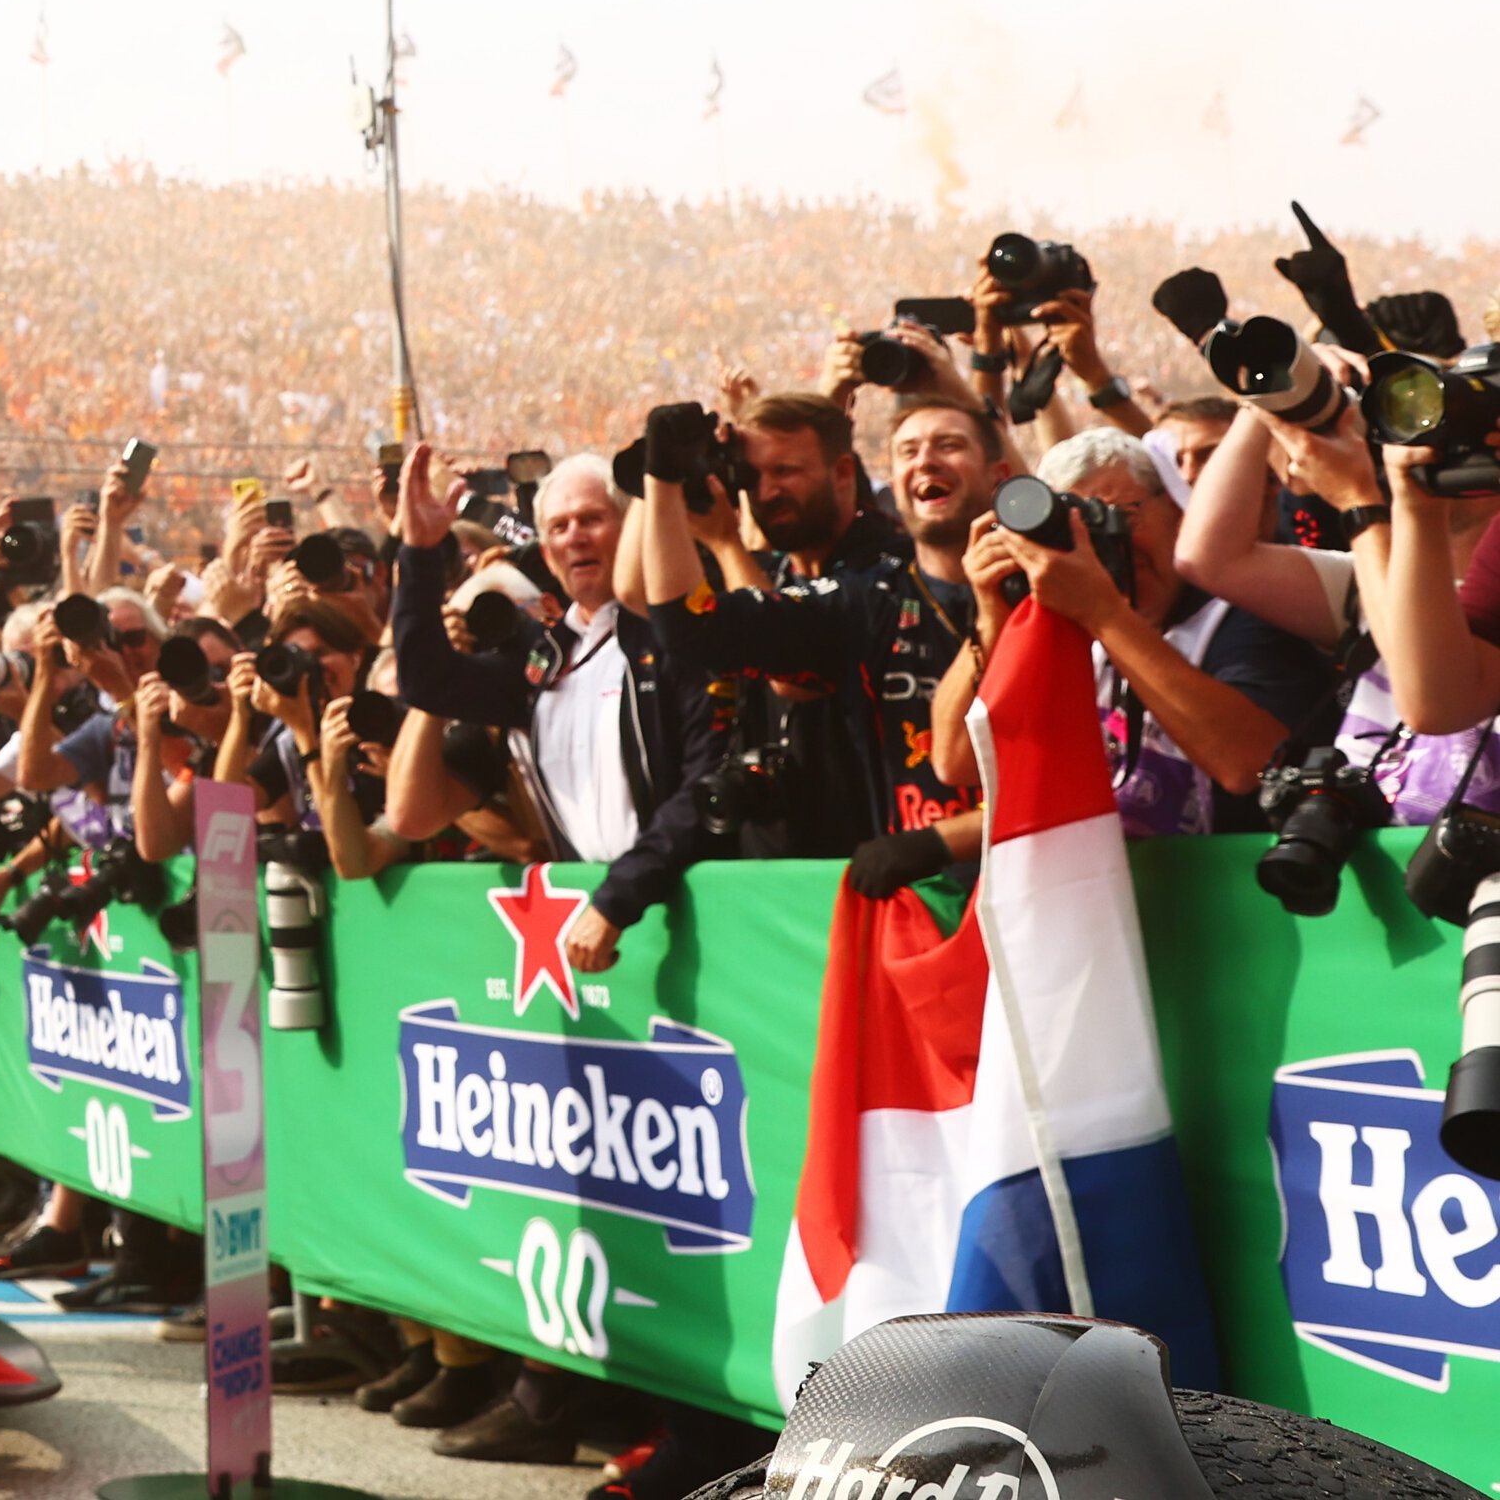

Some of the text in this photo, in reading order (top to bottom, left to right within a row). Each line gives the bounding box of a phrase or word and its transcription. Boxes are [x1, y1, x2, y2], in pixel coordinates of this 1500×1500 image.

[28, 973, 182, 1085] Heineken
[202, 931, 260, 1167] 3
[413, 1042, 730, 1201] Heineken
[1308, 1121, 1500, 1309] He
